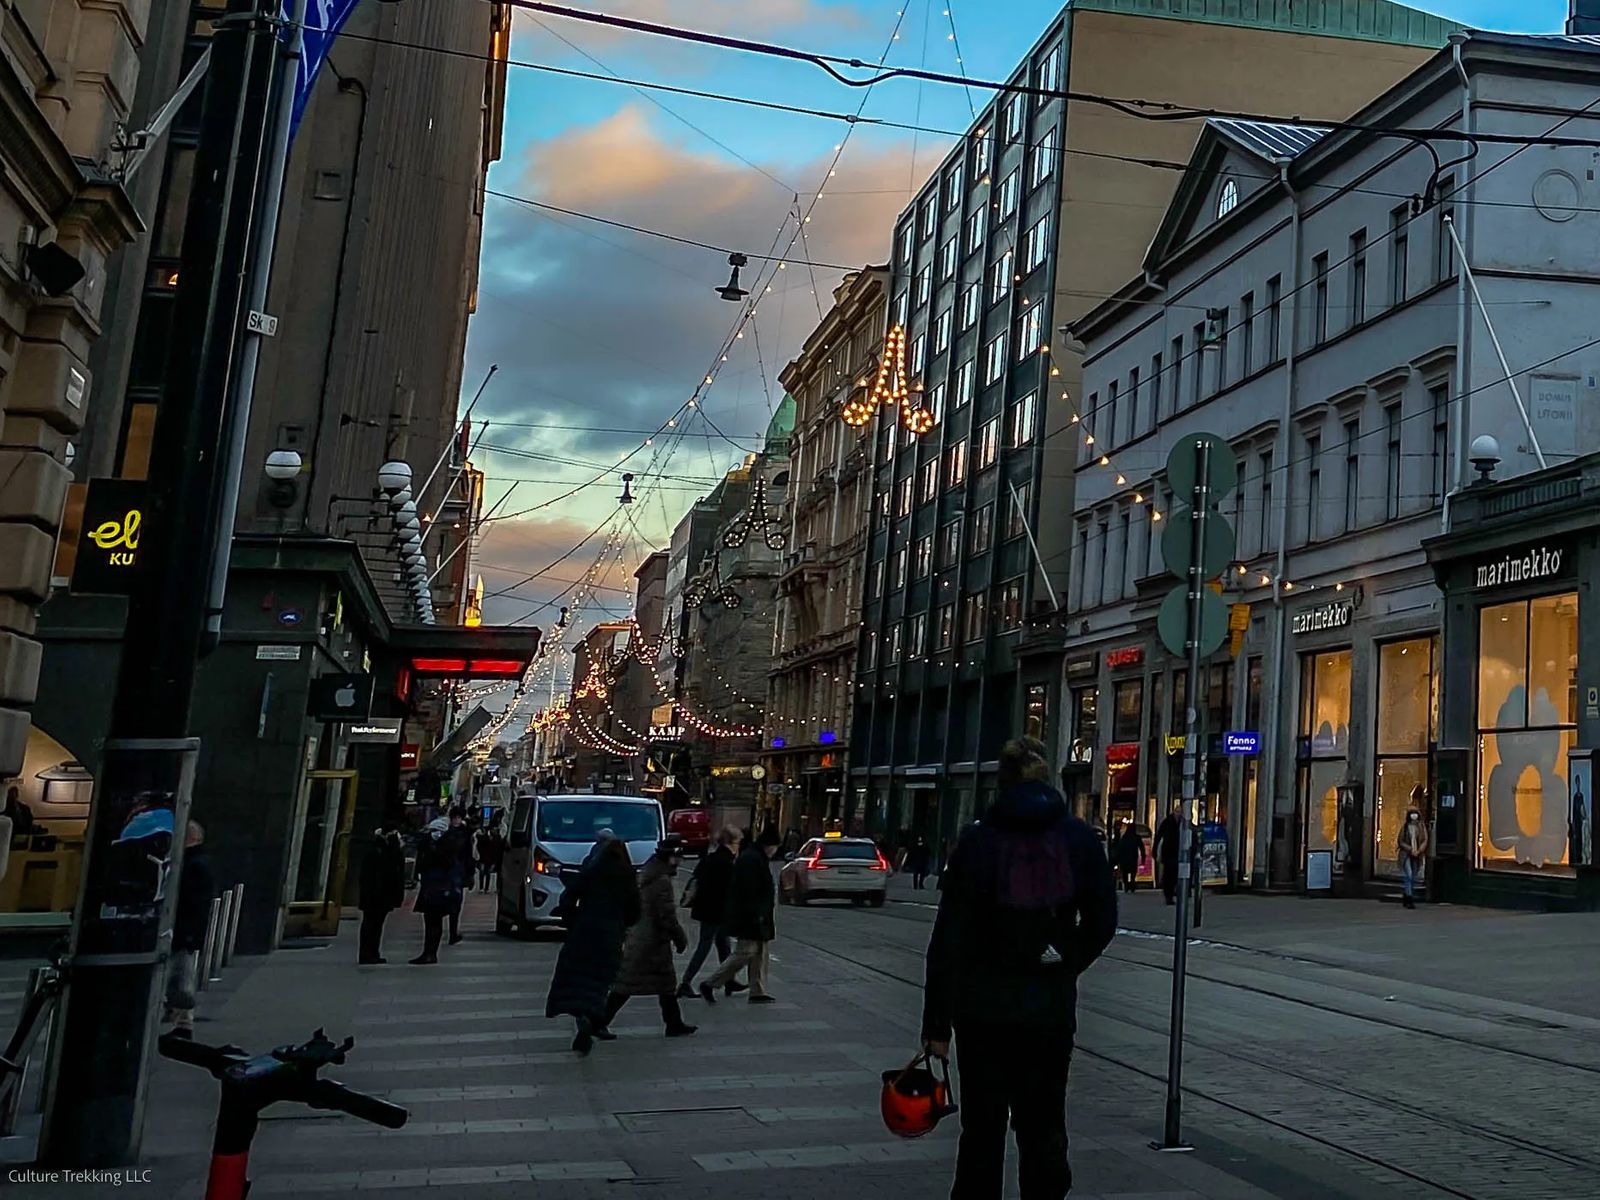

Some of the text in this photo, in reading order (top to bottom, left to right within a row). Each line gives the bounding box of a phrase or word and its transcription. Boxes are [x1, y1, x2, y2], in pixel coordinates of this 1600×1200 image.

[1477, 547, 1561, 588] marimekko
[1292, 601, 1350, 634] marimekko
[1227, 735, 1256, 745] Fenno
